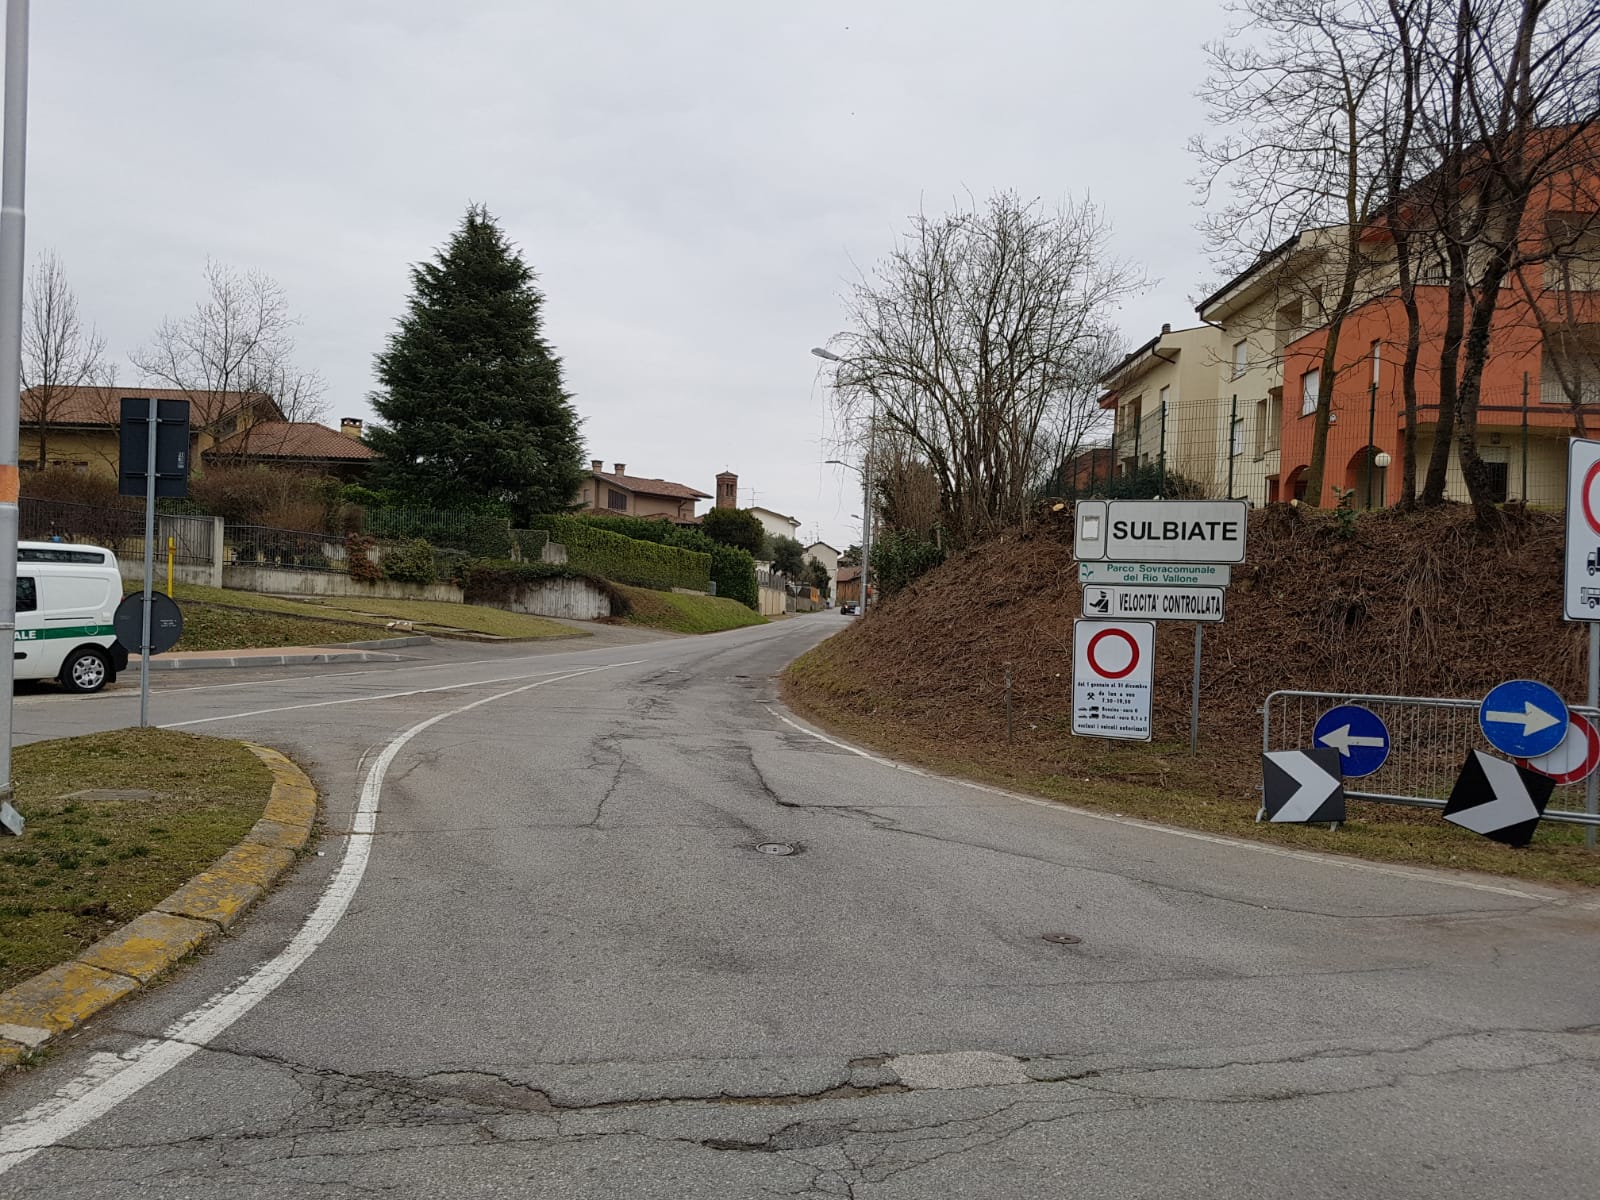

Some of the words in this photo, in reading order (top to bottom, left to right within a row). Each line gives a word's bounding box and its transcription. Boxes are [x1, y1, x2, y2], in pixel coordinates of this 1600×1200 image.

[1112, 520, 1238, 541] SULBIATE
[1106, 563, 1135, 572] Parco
[1138, 564, 1216, 575] Sovracomunale
[1123, 573, 1138, 582] del
[1142, 574, 1158, 583] Rio
[1162, 574, 1199, 584] Vallone
[1162, 594, 1221, 615] CONTROLLATA
